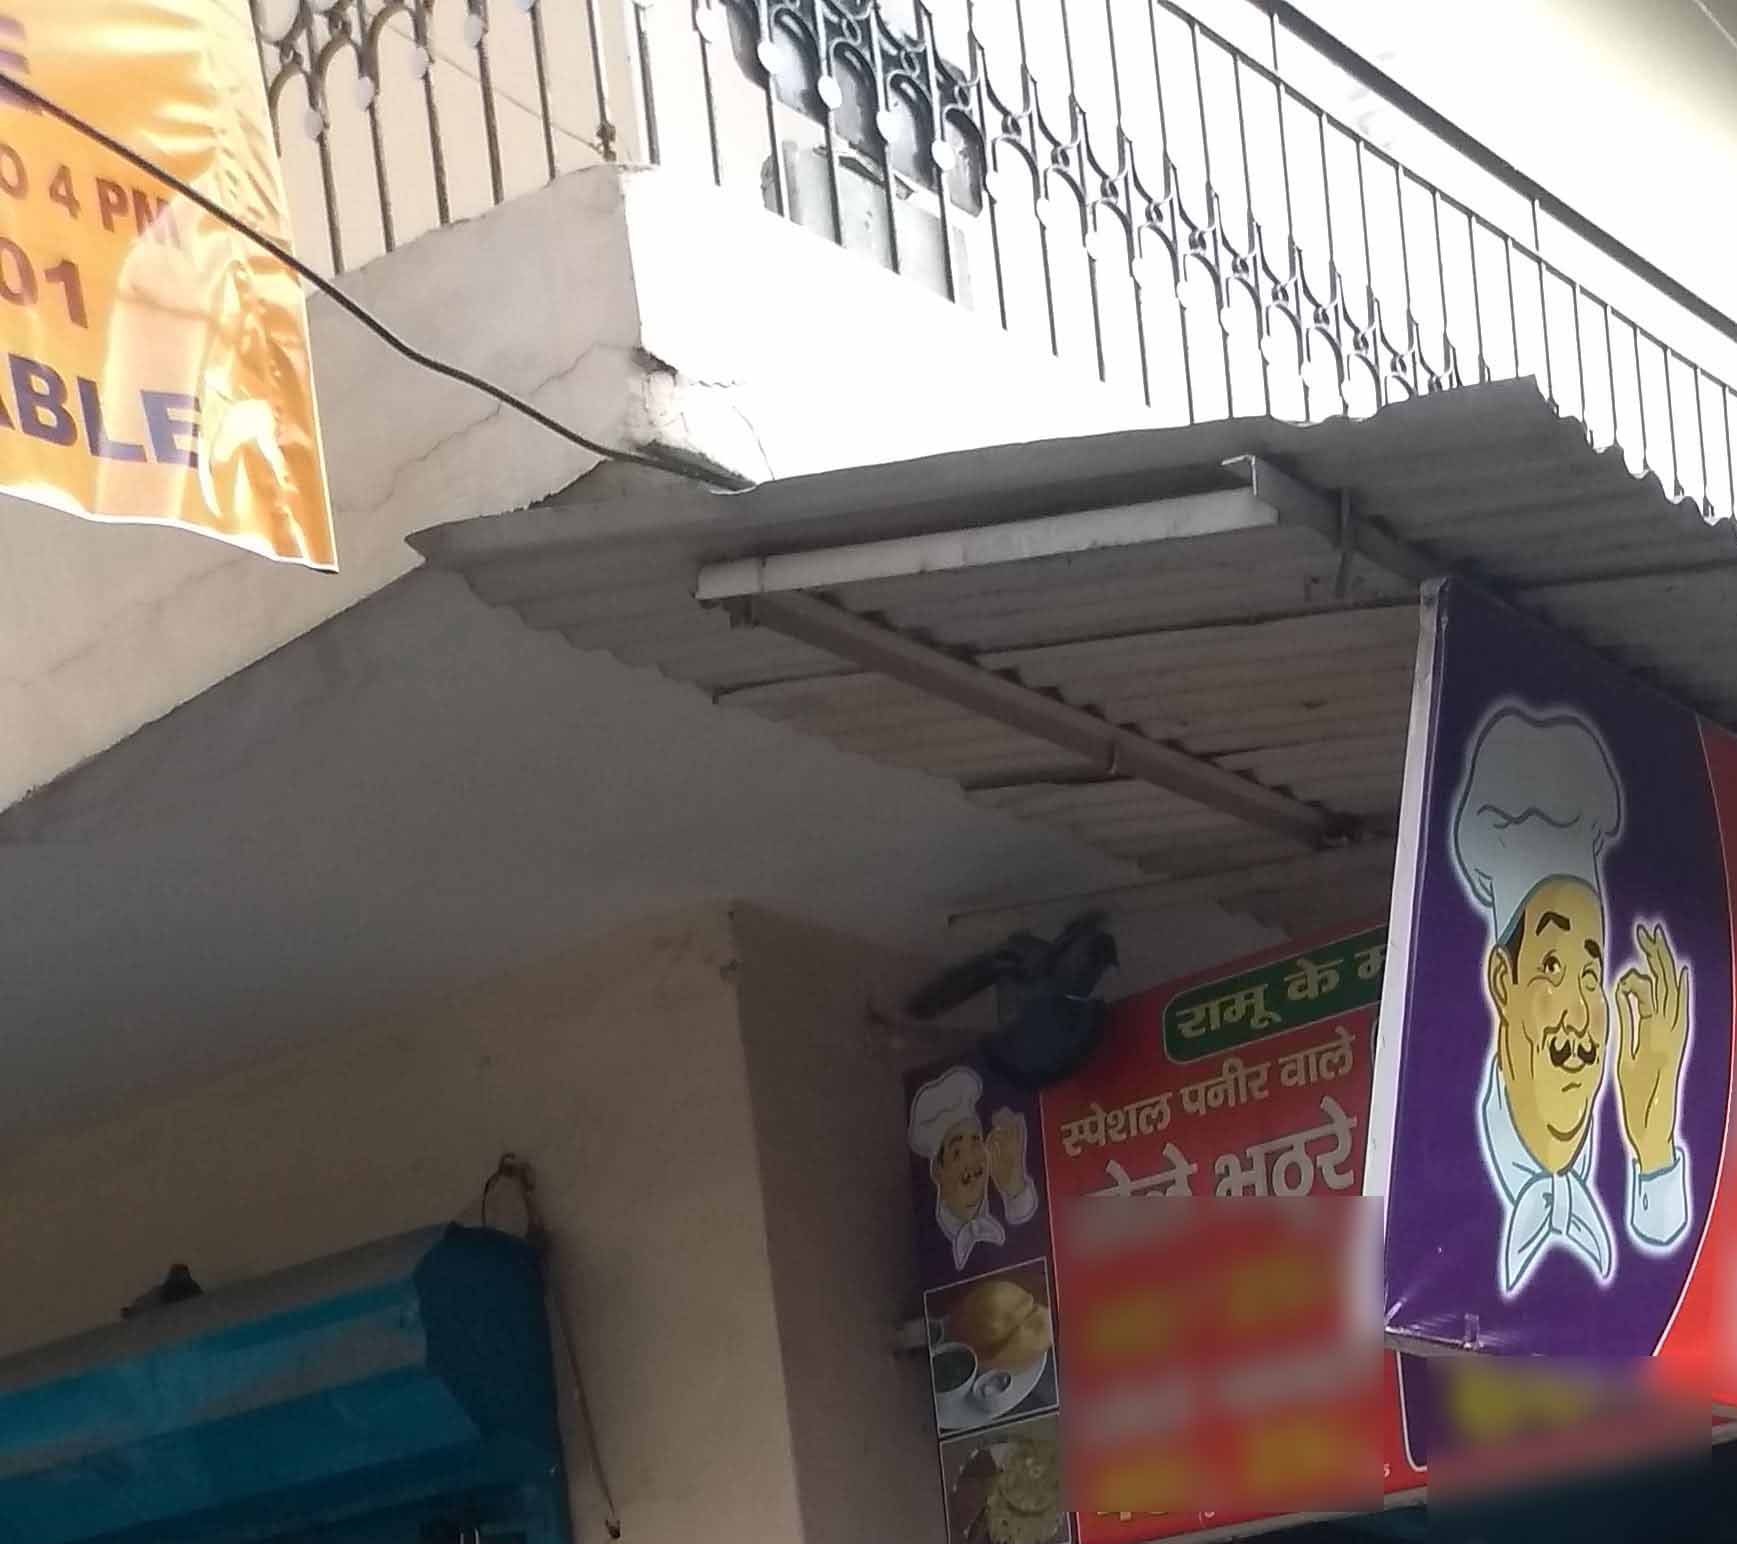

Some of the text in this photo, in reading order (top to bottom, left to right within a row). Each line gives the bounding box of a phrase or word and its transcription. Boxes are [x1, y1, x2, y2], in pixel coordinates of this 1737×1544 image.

[49, 163, 80, 219] 4
[0, 352, 200, 469] BLE
[1176, 984, 1282, 1040] रामू
[1284, 957, 1344, 1001] के
[1061, 1025, 1356, 1157] स्पेशल पनीर वाले
